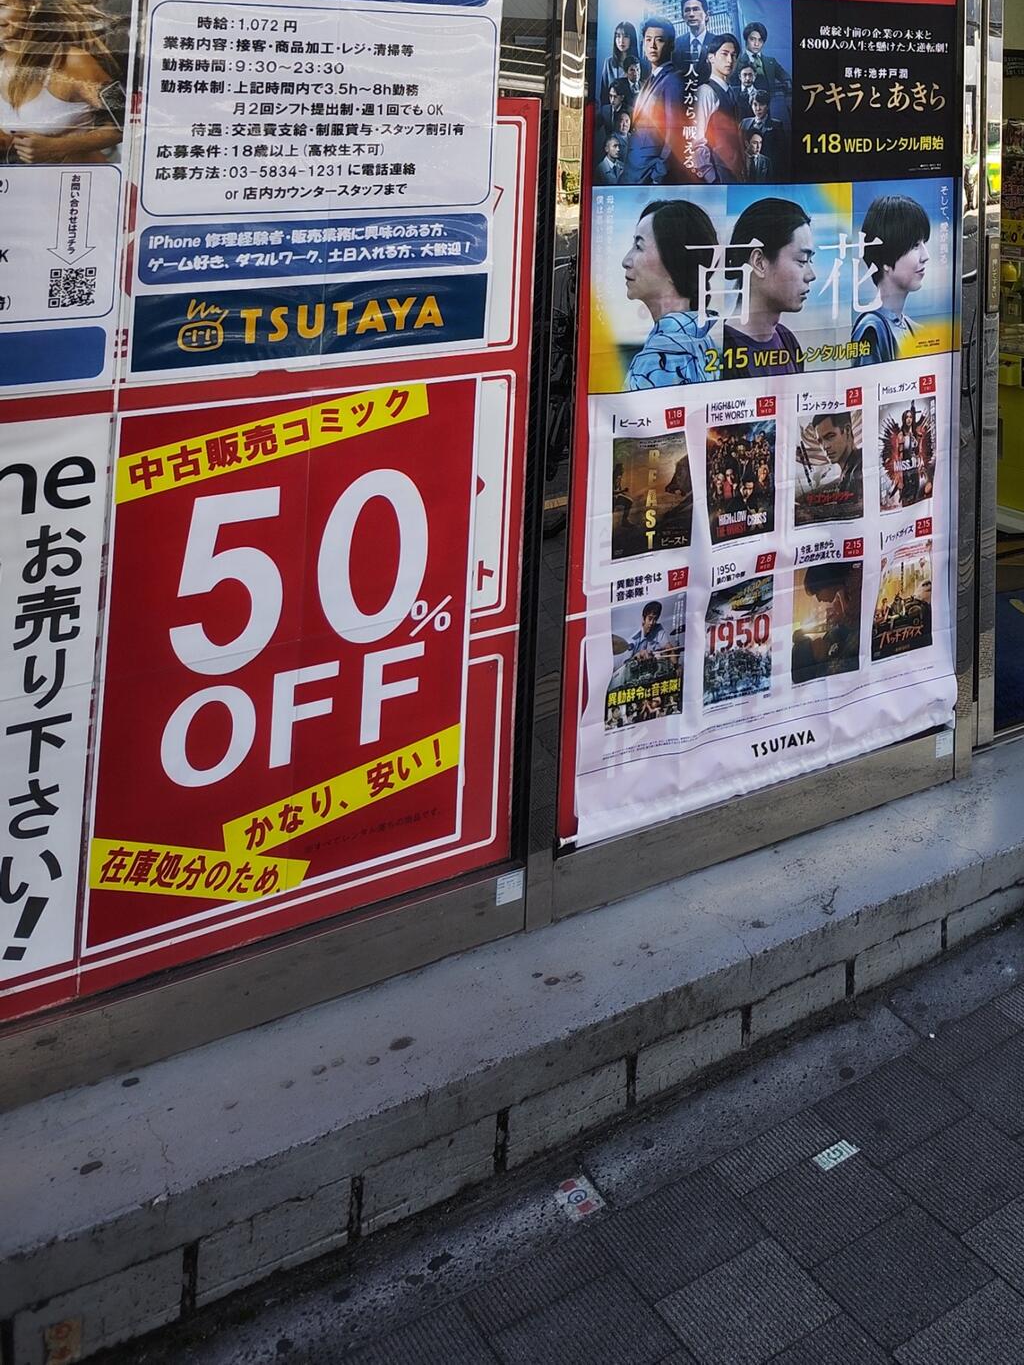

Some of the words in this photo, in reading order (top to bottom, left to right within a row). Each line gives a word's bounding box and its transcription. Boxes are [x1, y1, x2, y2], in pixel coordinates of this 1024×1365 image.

[284, 19, 298, 34] 円
[819, 25, 932, 40] 破綻寸前の企業の未来と
[163, 35, 414, 58] 業務内容：接客・商品加工・レジ・清掃等
[844, 67, 909, 80] 原作：池井戸潤
[801, 81, 946, 113] アキラとあきら
[427, 104, 444, 116] OK
[802, 133, 842, 154] 1.18
[844, 138, 873, 153] WED
[876, 135, 945, 151] レンタル開始
[348, 162, 417, 177] に電話連絡
[225, 189, 239, 201] or
[242, 183, 408, 201] 店内カウンタースタッフまで
[68, 174, 81, 255] お問い合わせはコチラ
[148, 235, 201, 250] iPhone
[684, 231, 884, 328] 百花
[240, 295, 445, 344] TSUTAYA
[703, 347, 749, 372] 2.15
[753, 349, 790, 367] WED
[795, 341, 871, 363] レンタル開始
[922, 377, 933, 386] 2.3
[848, 388, 860, 398] 2.3
[758, 398, 774, 408] 1.25
[802, 400, 845, 411] コントラクター
[667, 409, 683, 419] 1.18
[711, 413, 724, 422] THE
[725, 410, 749, 421] WORST
[749, 409, 755, 418] X
[619, 417, 652, 428] ビースト
[128, 387, 411, 491] 中古販売コミック
[917, 519, 931, 529] 2.15
[661, 536, 688, 547] ビースト
[845, 540, 862, 549] 2.15
[760, 555, 772, 565] 2.8
[168, 467, 453, 677] 50%
[672, 571, 685, 581] 2.3
[716, 563, 737, 576] 1950
[616, 572, 663, 590] 異動辞令は
[616, 587, 649, 602] 音楽隊！
[706, 613, 771, 657] 1950
[607, 678, 681, 707] 異動辞令は音楽隊！
[160, 640, 427, 789] OFF
[1, 524, 85, 961] お売り下さい！
[751, 730, 816, 758] TSUTAYA
[244, 737, 445, 851] かなり、安い！
